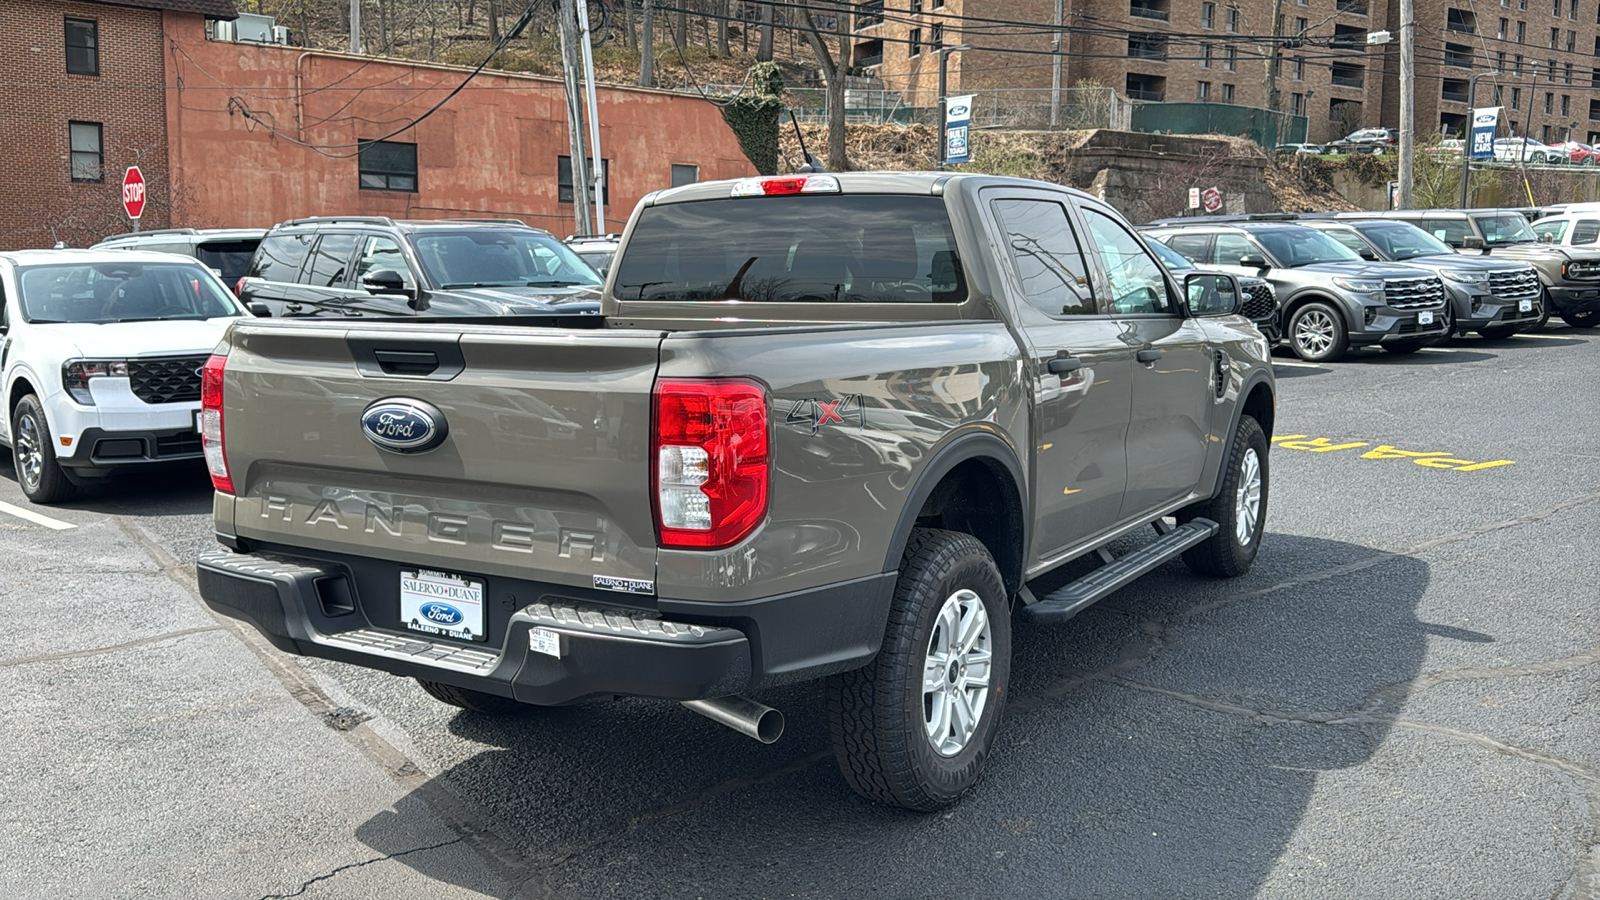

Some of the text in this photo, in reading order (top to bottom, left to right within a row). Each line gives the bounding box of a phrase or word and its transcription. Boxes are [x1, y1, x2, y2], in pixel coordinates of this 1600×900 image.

[949, 129, 966, 139] BUILT
[1475, 132, 1492, 144] NEW
[1474, 142, 1492, 153] CARS
[125, 182, 144, 203] STOP
[376, 412, 415, 438] Ford
[260, 495, 606, 563] RANGER
[403, 580, 480, 602] SALERNO DUANE
[595, 576, 623, 587] SALERNO
[629, 581, 652, 590] DUANE
[427, 605, 455, 623] Ford
[407, 622, 473, 641] SALERNO DUANE
